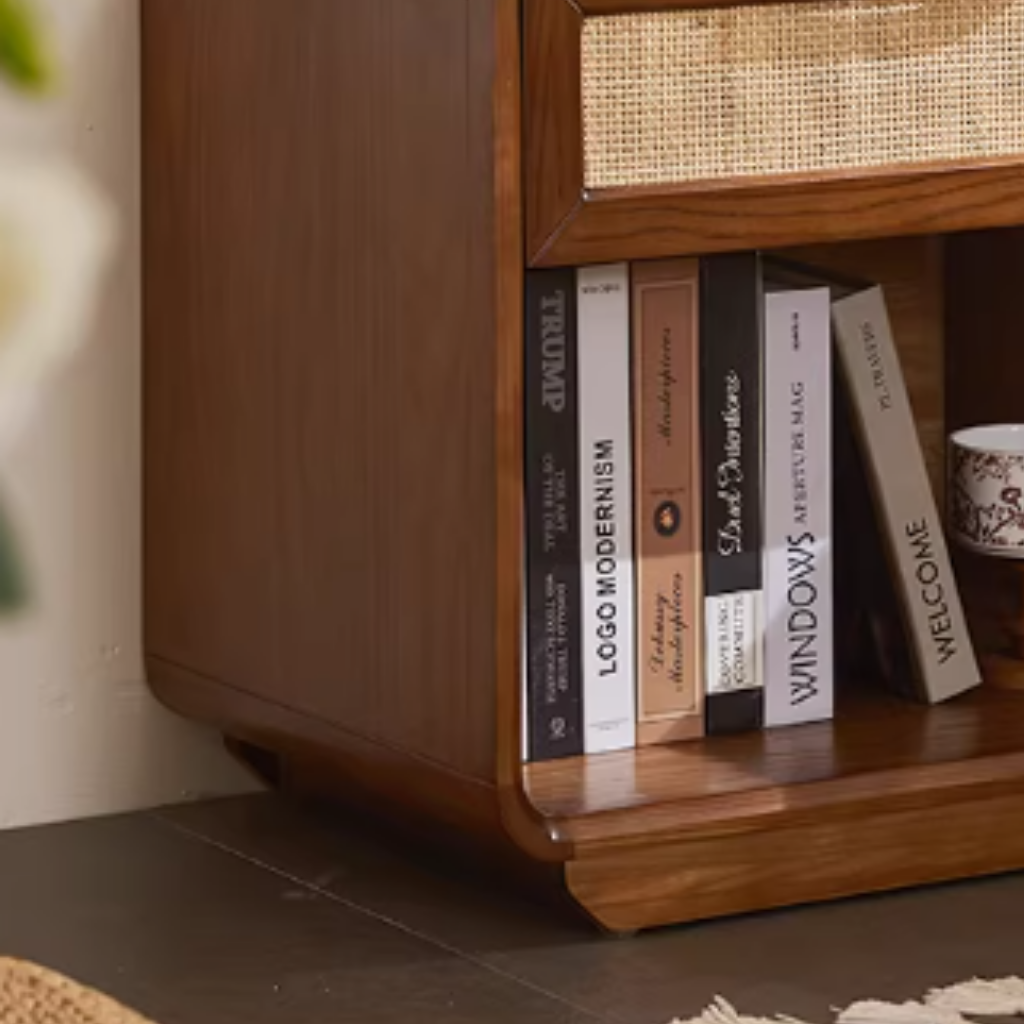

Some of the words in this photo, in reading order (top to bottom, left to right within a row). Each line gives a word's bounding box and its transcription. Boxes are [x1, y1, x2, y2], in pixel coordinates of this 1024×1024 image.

[541, 289, 566, 412] TRUMP
[594, 440, 616, 597] MODERNISM
[906, 518, 957, 665] WELCOME
[597, 602, 617, 676] LOGO
[786, 531, 818, 706] WINDOWS
